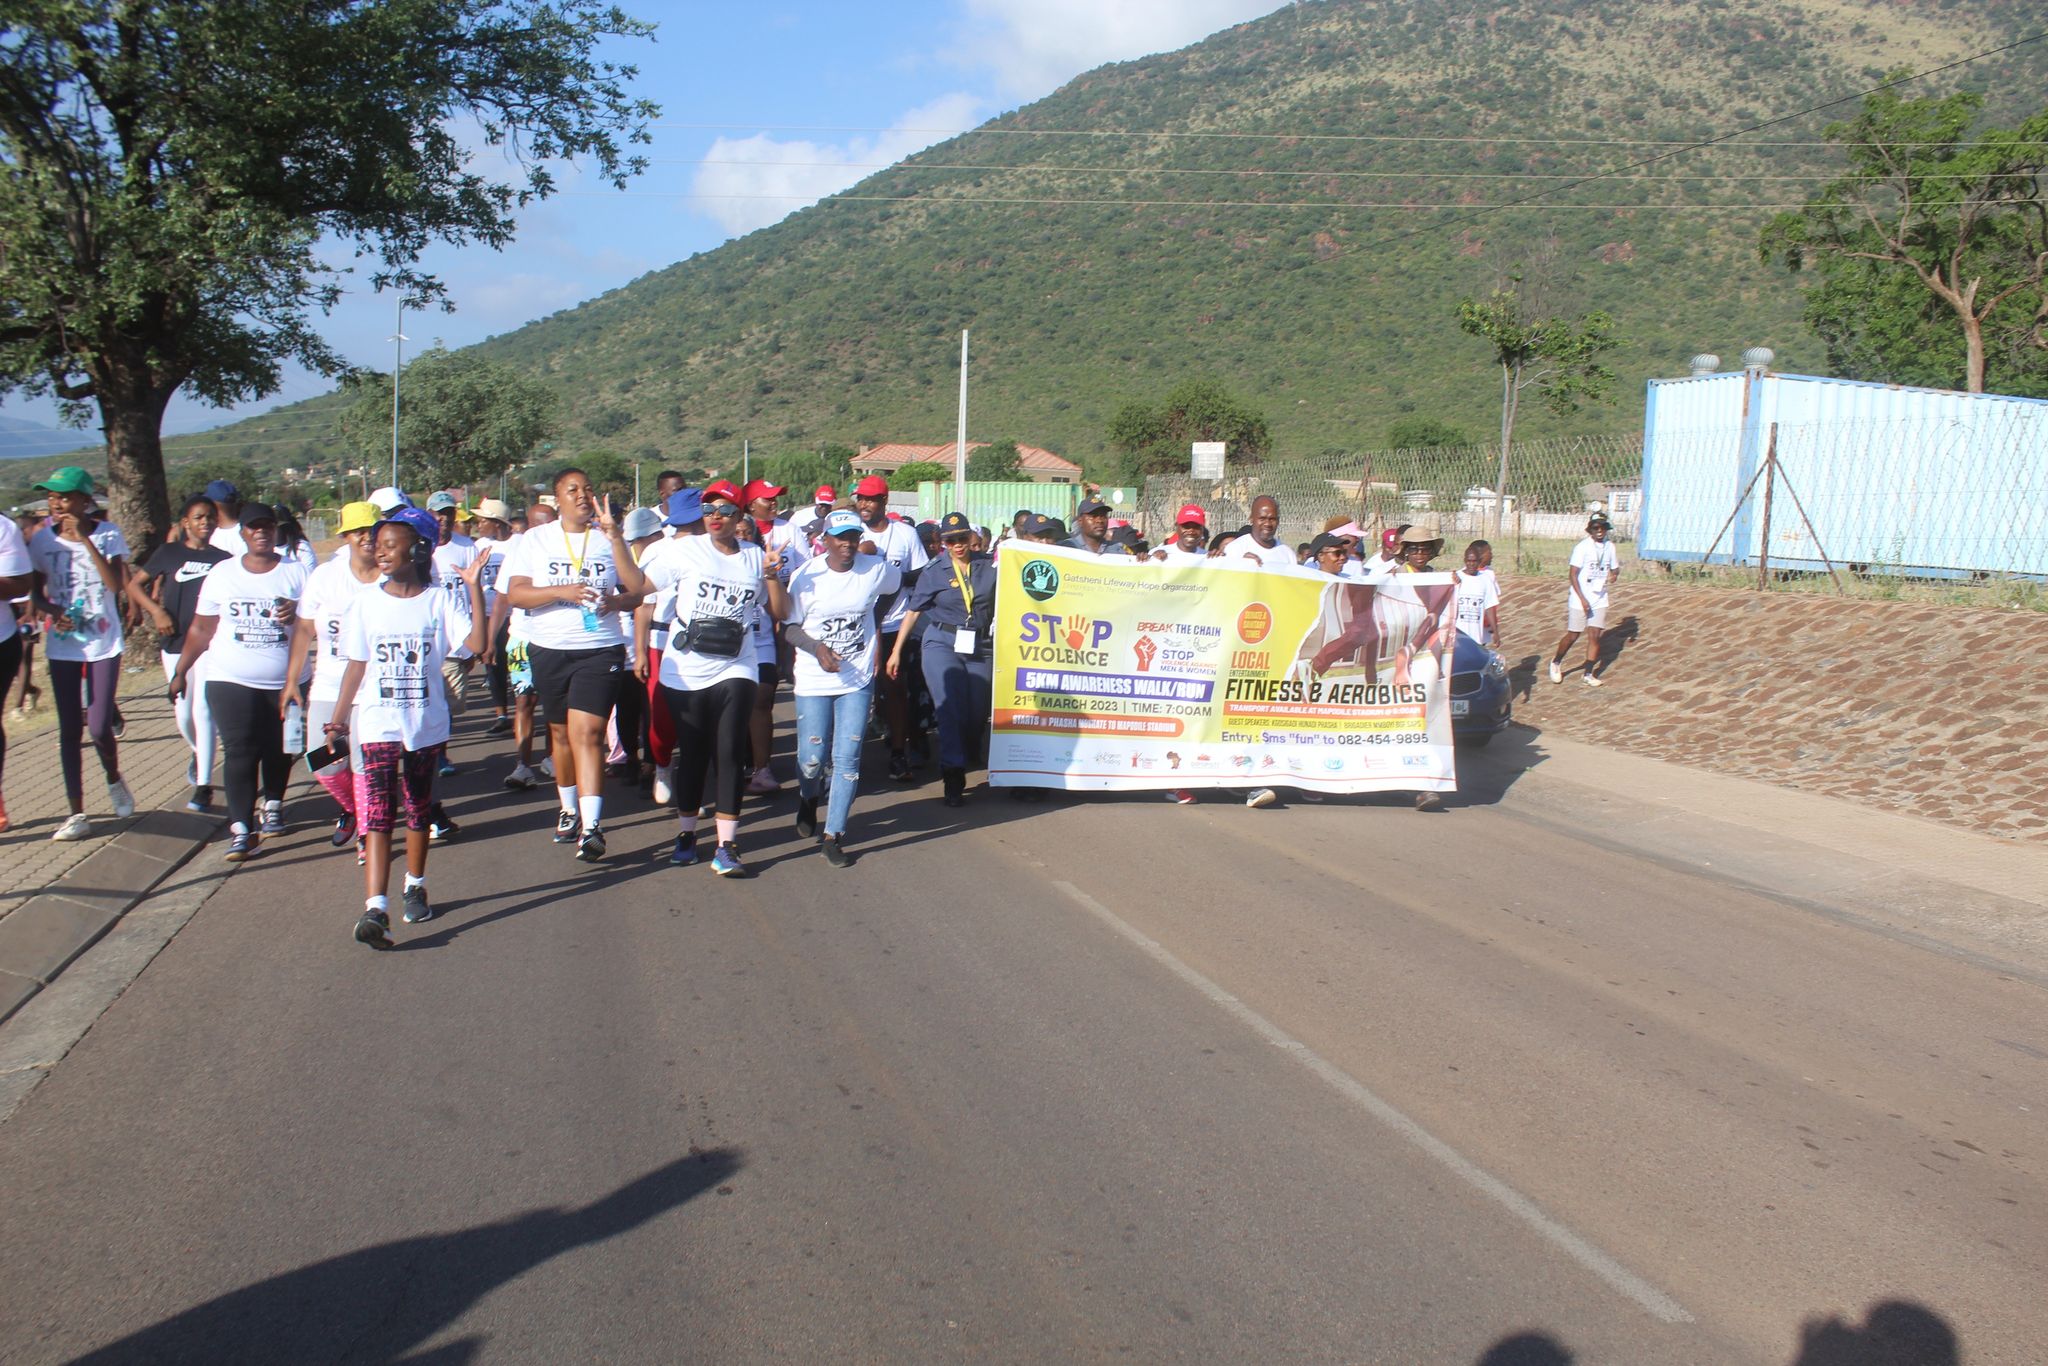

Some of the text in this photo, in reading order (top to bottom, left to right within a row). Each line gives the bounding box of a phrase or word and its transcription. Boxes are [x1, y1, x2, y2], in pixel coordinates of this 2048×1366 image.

[182, 561, 212, 573] NIKE
[1063, 573, 1209, 593] Gatsheni Lifeway Hope Organization
[1136, 622, 1222, 637] BREAK THE CHAIN
[1019, 645, 1109, 667] VIOLENCE
[1162, 649, 1195, 660] STOP
[1231, 651, 1270, 669] LOCAL
[1187, 667, 1217, 675] WOMEN
[1229, 670, 1270, 678] ENTERTAINMENT
[1025, 671, 1206, 699] 5KM AWARENESS WALK/RUN
[1225, 679, 1427, 704] FITNESS & AEROBICS
[1014, 695, 1037, 706] 21ST
[1040, 697, 1087, 710] MARCH
[1090, 700, 1118, 711] 2023
[1131, 702, 1163, 714] TIME:
[1165, 704, 1212, 717] 7:00AM
[1229, 704, 1270, 713] TRANSPORT
[1270, 705, 1307, 714] AVAILABLE
[1012, 714, 1040, 726] STARTS
[1107, 719, 1116, 730] TO
[1228, 718, 1244, 726] GUEST
[1222, 731, 1252, 743] Entry
[1262, 732, 1286, 744] Sms
[1289, 733, 1320, 744] "fun"
[1323, 735, 1335, 745] to
[1338, 733, 1429, 745] 082-454-9895
